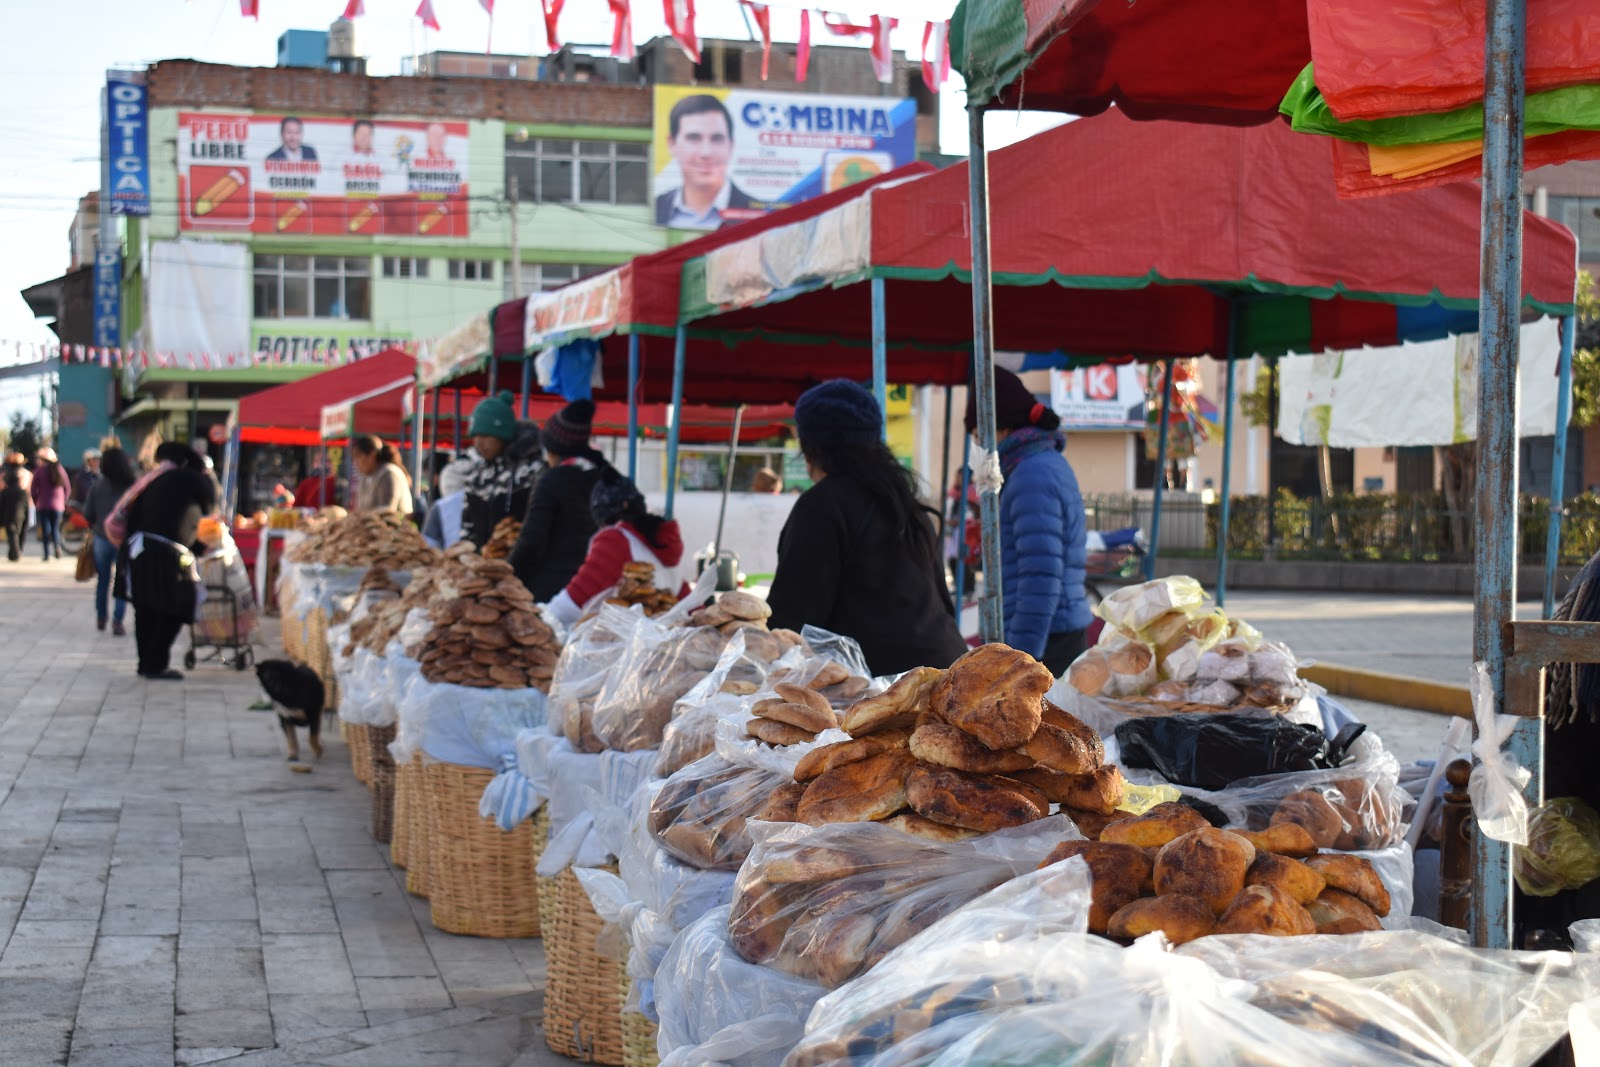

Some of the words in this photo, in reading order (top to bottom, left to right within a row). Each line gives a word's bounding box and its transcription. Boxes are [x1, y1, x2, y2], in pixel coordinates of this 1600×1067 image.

[113, 86, 142, 191] OPTICA
[190, 118, 248, 141] PERÚ
[191, 142, 246, 160] LIBRE
[257, 336, 340, 365] BOTICA
[1088, 368, 1112, 397] K
